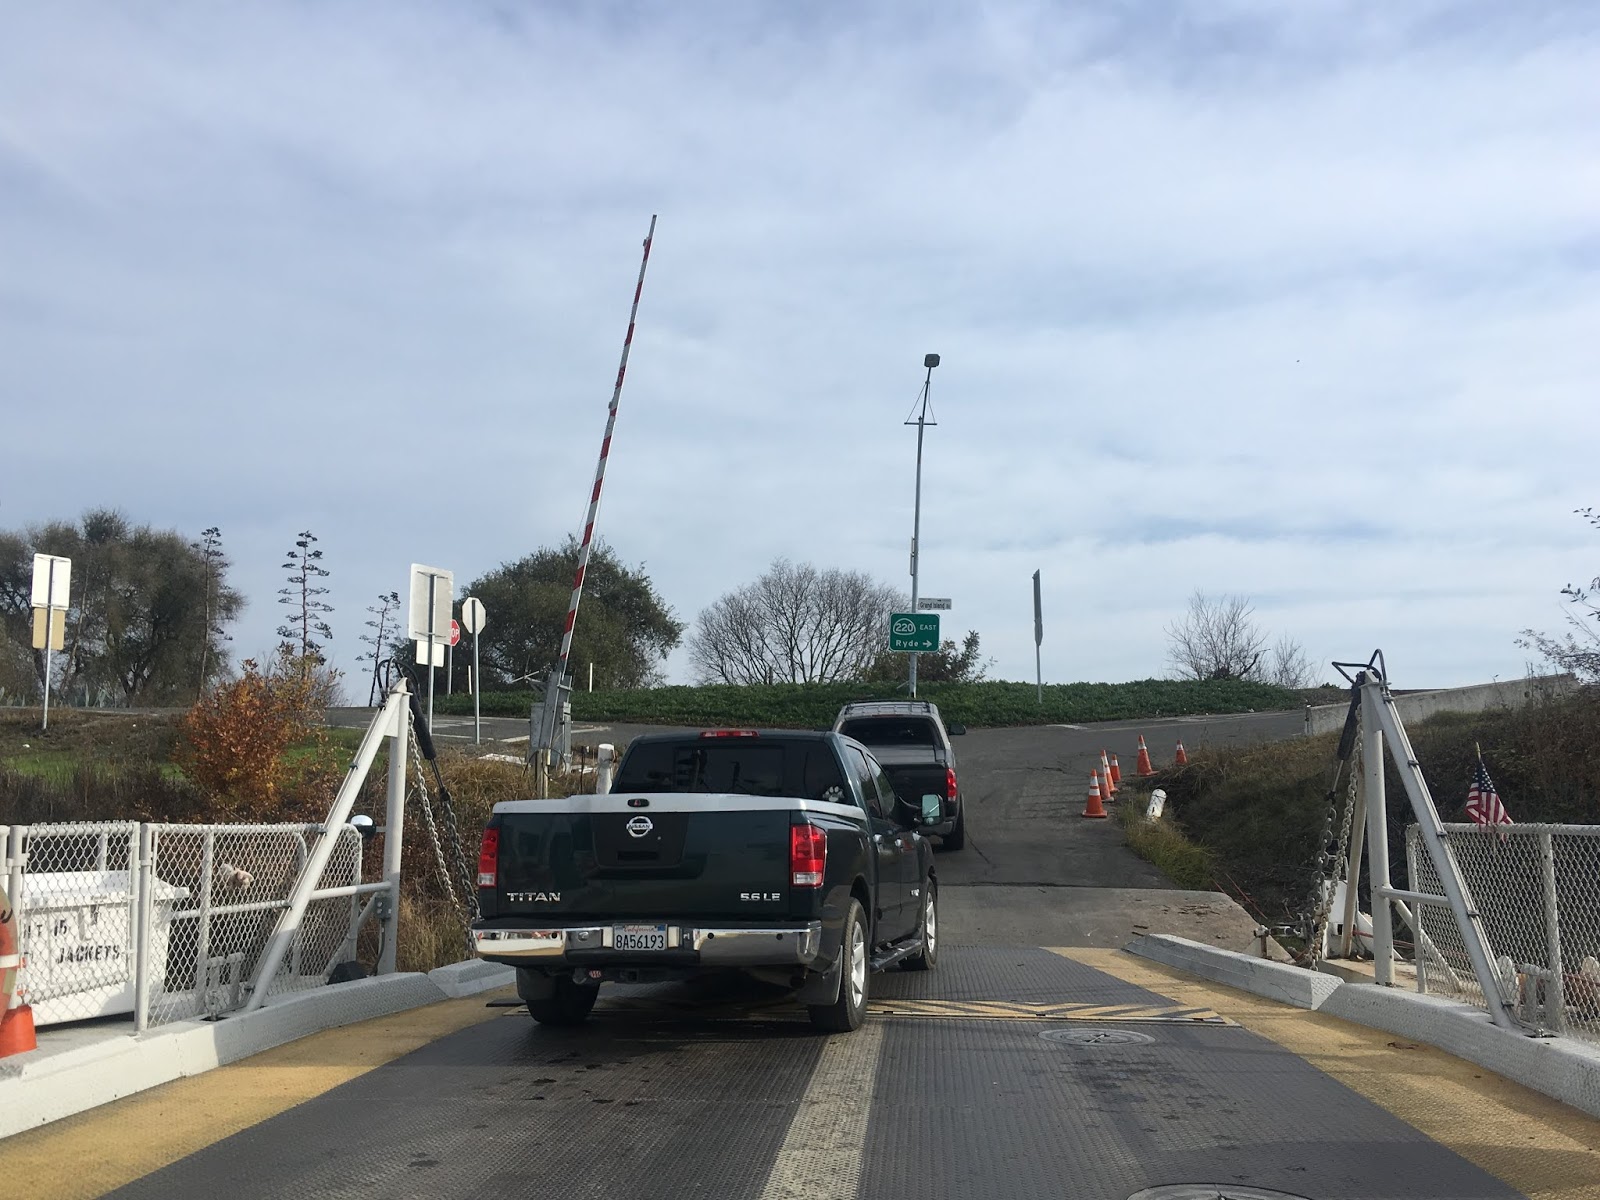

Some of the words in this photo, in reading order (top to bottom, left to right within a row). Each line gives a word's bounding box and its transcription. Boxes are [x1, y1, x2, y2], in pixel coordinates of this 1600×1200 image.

[895, 623, 914, 632] 220
[895, 640, 919, 648] Ryde
[506, 892, 561, 902] TITAN
[763, 892, 780, 902] LE
[616, 934, 664, 949] 8A56193
[55, 945, 120, 964] JACKETS
